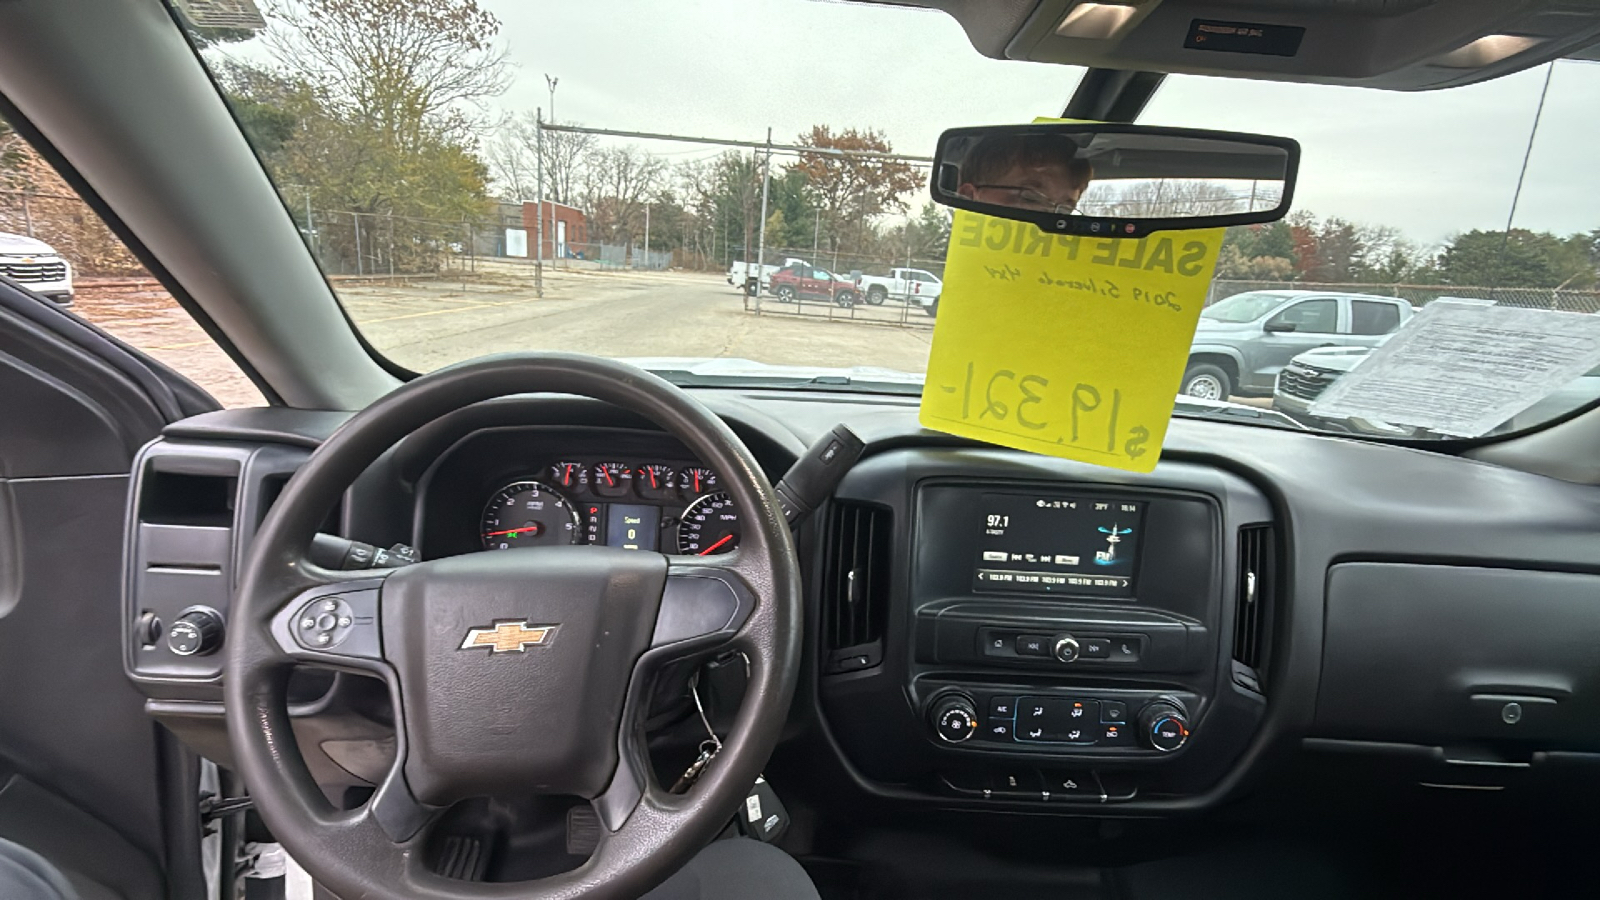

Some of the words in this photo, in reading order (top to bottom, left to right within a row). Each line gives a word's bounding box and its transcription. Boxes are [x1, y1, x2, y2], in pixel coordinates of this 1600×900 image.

[506, 498, 515, 506] 2
[565, 522, 573, 530] 5
[986, 514, 1009, 528] 97.1
[627, 528, 636, 540] 0
